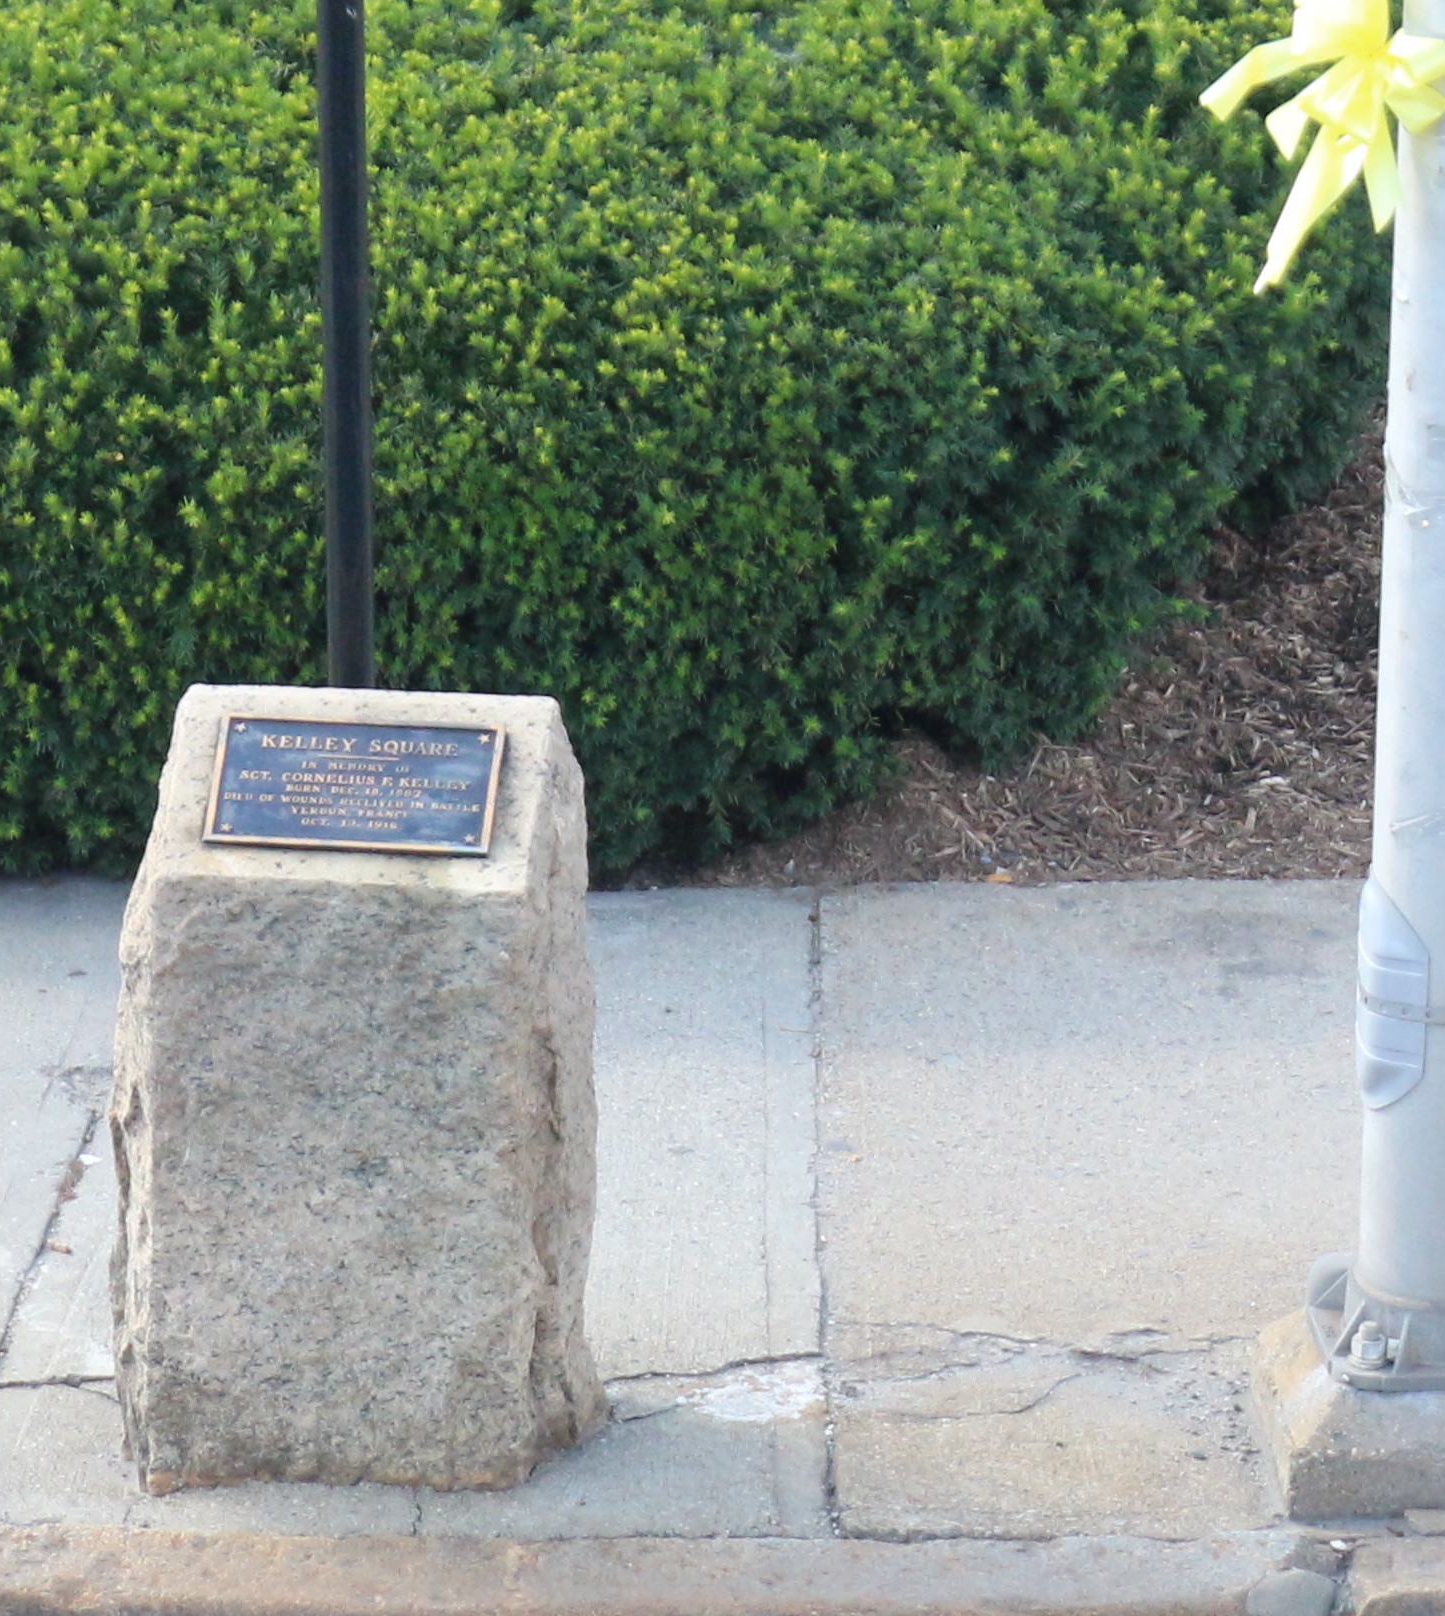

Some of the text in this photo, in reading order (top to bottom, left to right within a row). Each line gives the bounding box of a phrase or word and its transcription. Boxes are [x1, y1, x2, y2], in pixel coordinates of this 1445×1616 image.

[260, 734, 459, 757] KELLEY SQUARE
[328, 761, 386, 773] MEMORY
[281, 771, 376, 786] CORNELIUS
[399, 776, 471, 791] KELLEY
[285, 784, 321, 793] BORN
[259, 793, 275, 802] OF
[281, 794, 333, 805] WOUNDS
[410, 801, 425, 810] IN
